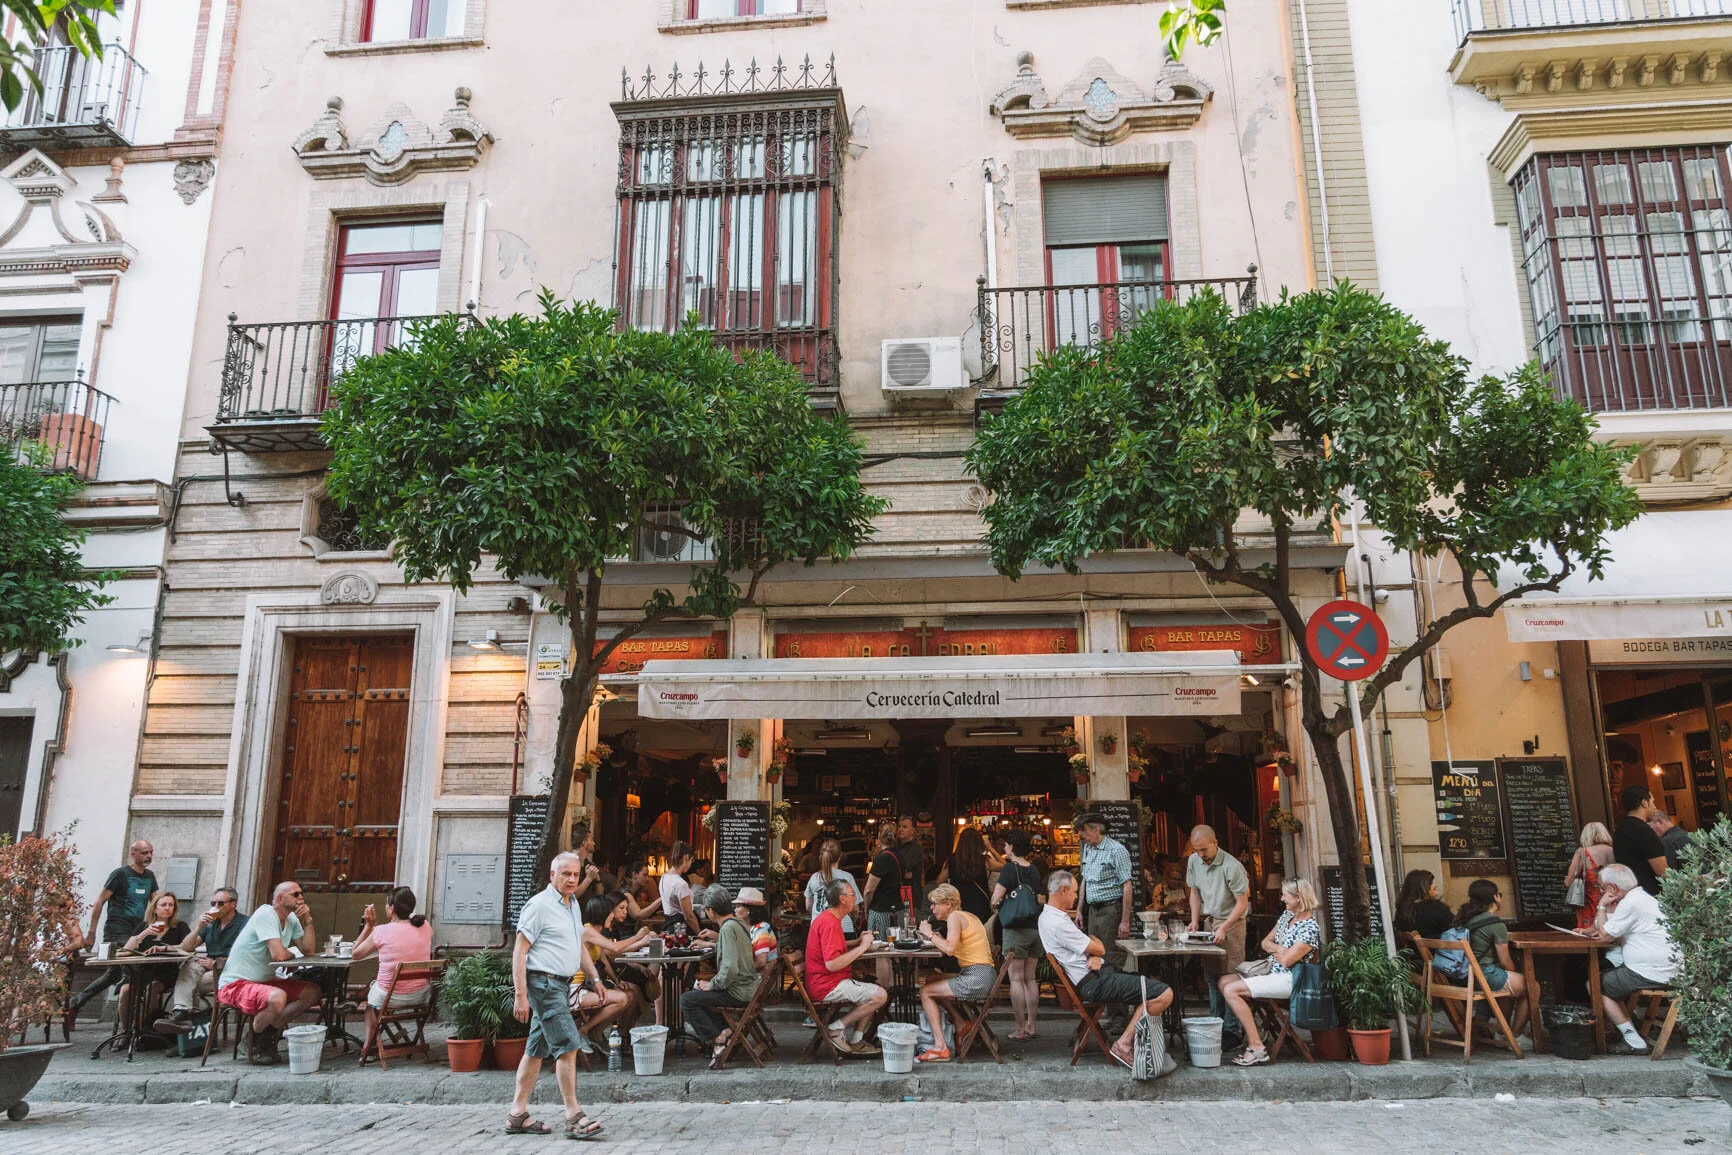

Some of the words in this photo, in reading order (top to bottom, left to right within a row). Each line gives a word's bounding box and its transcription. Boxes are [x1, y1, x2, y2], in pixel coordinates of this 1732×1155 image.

[1525, 619, 1564, 627] Cruzcampo
[1704, 609, 1725, 629] LA
[1167, 631, 1194, 642] BAR
[1198, 630, 1241, 641] TAPAS
[621, 642, 646, 653] BAR
[650, 641, 689, 653] TAPAS
[1623, 641, 1668, 653] BODEGA
[1673, 641, 1695, 652] BAR
[1698, 640, 1732, 651] TAPAS
[660, 691, 698, 701] Cruzcampo
[1175, 687, 1216, 697] Cruzcampo
[866, 691, 941, 707] Cervecería
[942, 690, 1000, 707] Catedral
[1520, 765, 1544, 774] TAPAS
